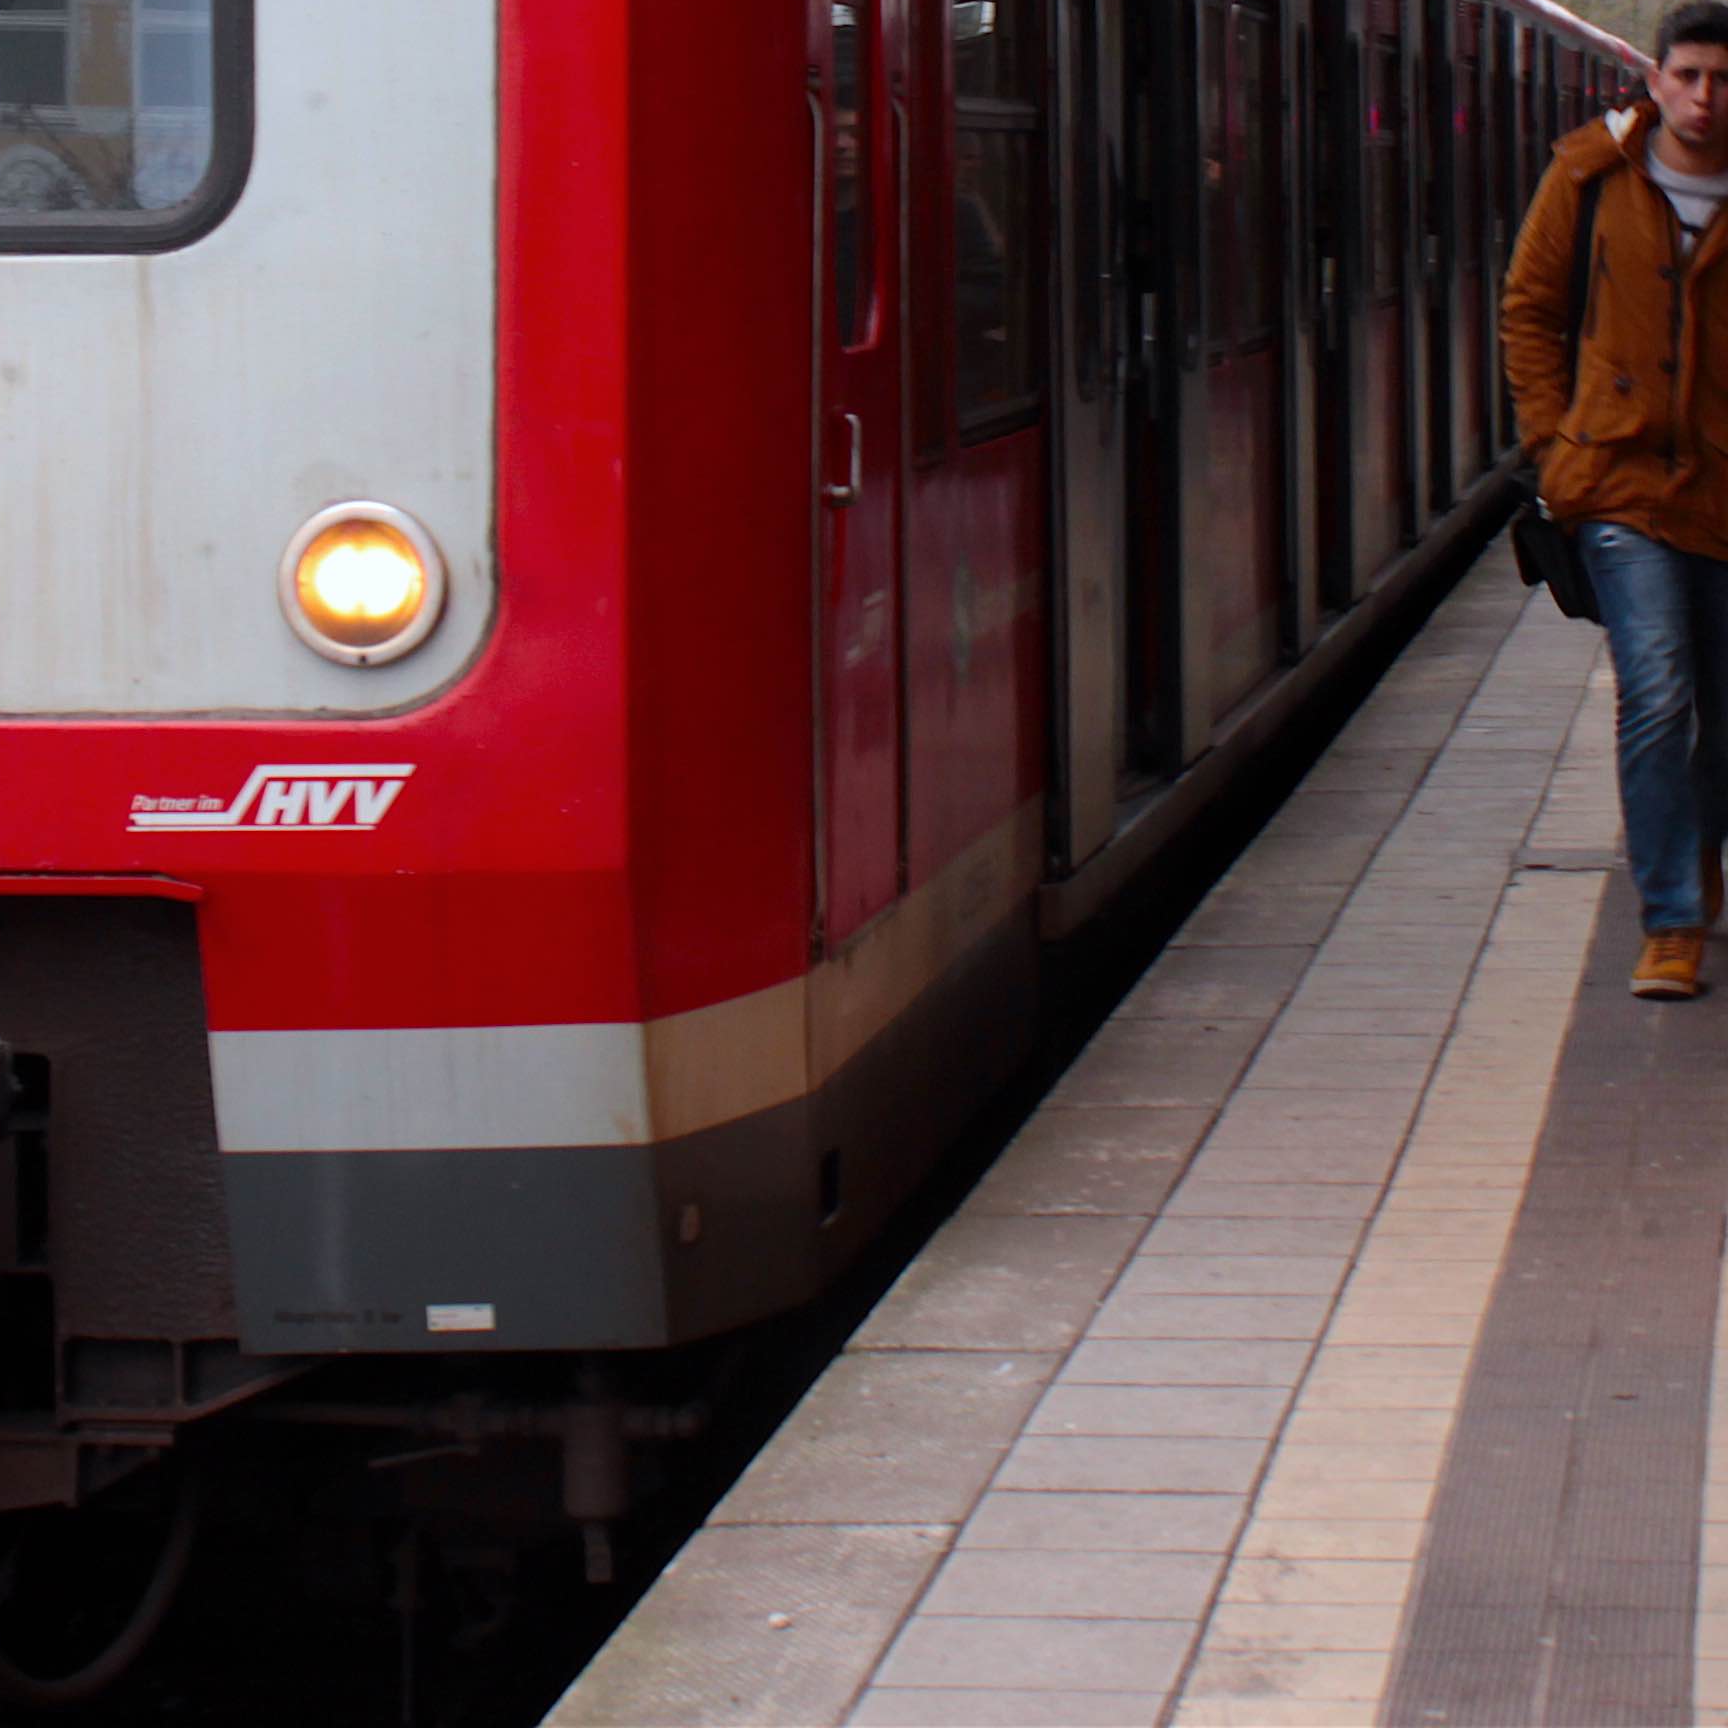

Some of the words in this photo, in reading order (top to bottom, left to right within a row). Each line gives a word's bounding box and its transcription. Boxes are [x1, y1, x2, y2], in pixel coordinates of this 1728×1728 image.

[131, 794, 194, 812] Partner
[196, 794, 224, 811] im
[255, 780, 405, 825] HVV
